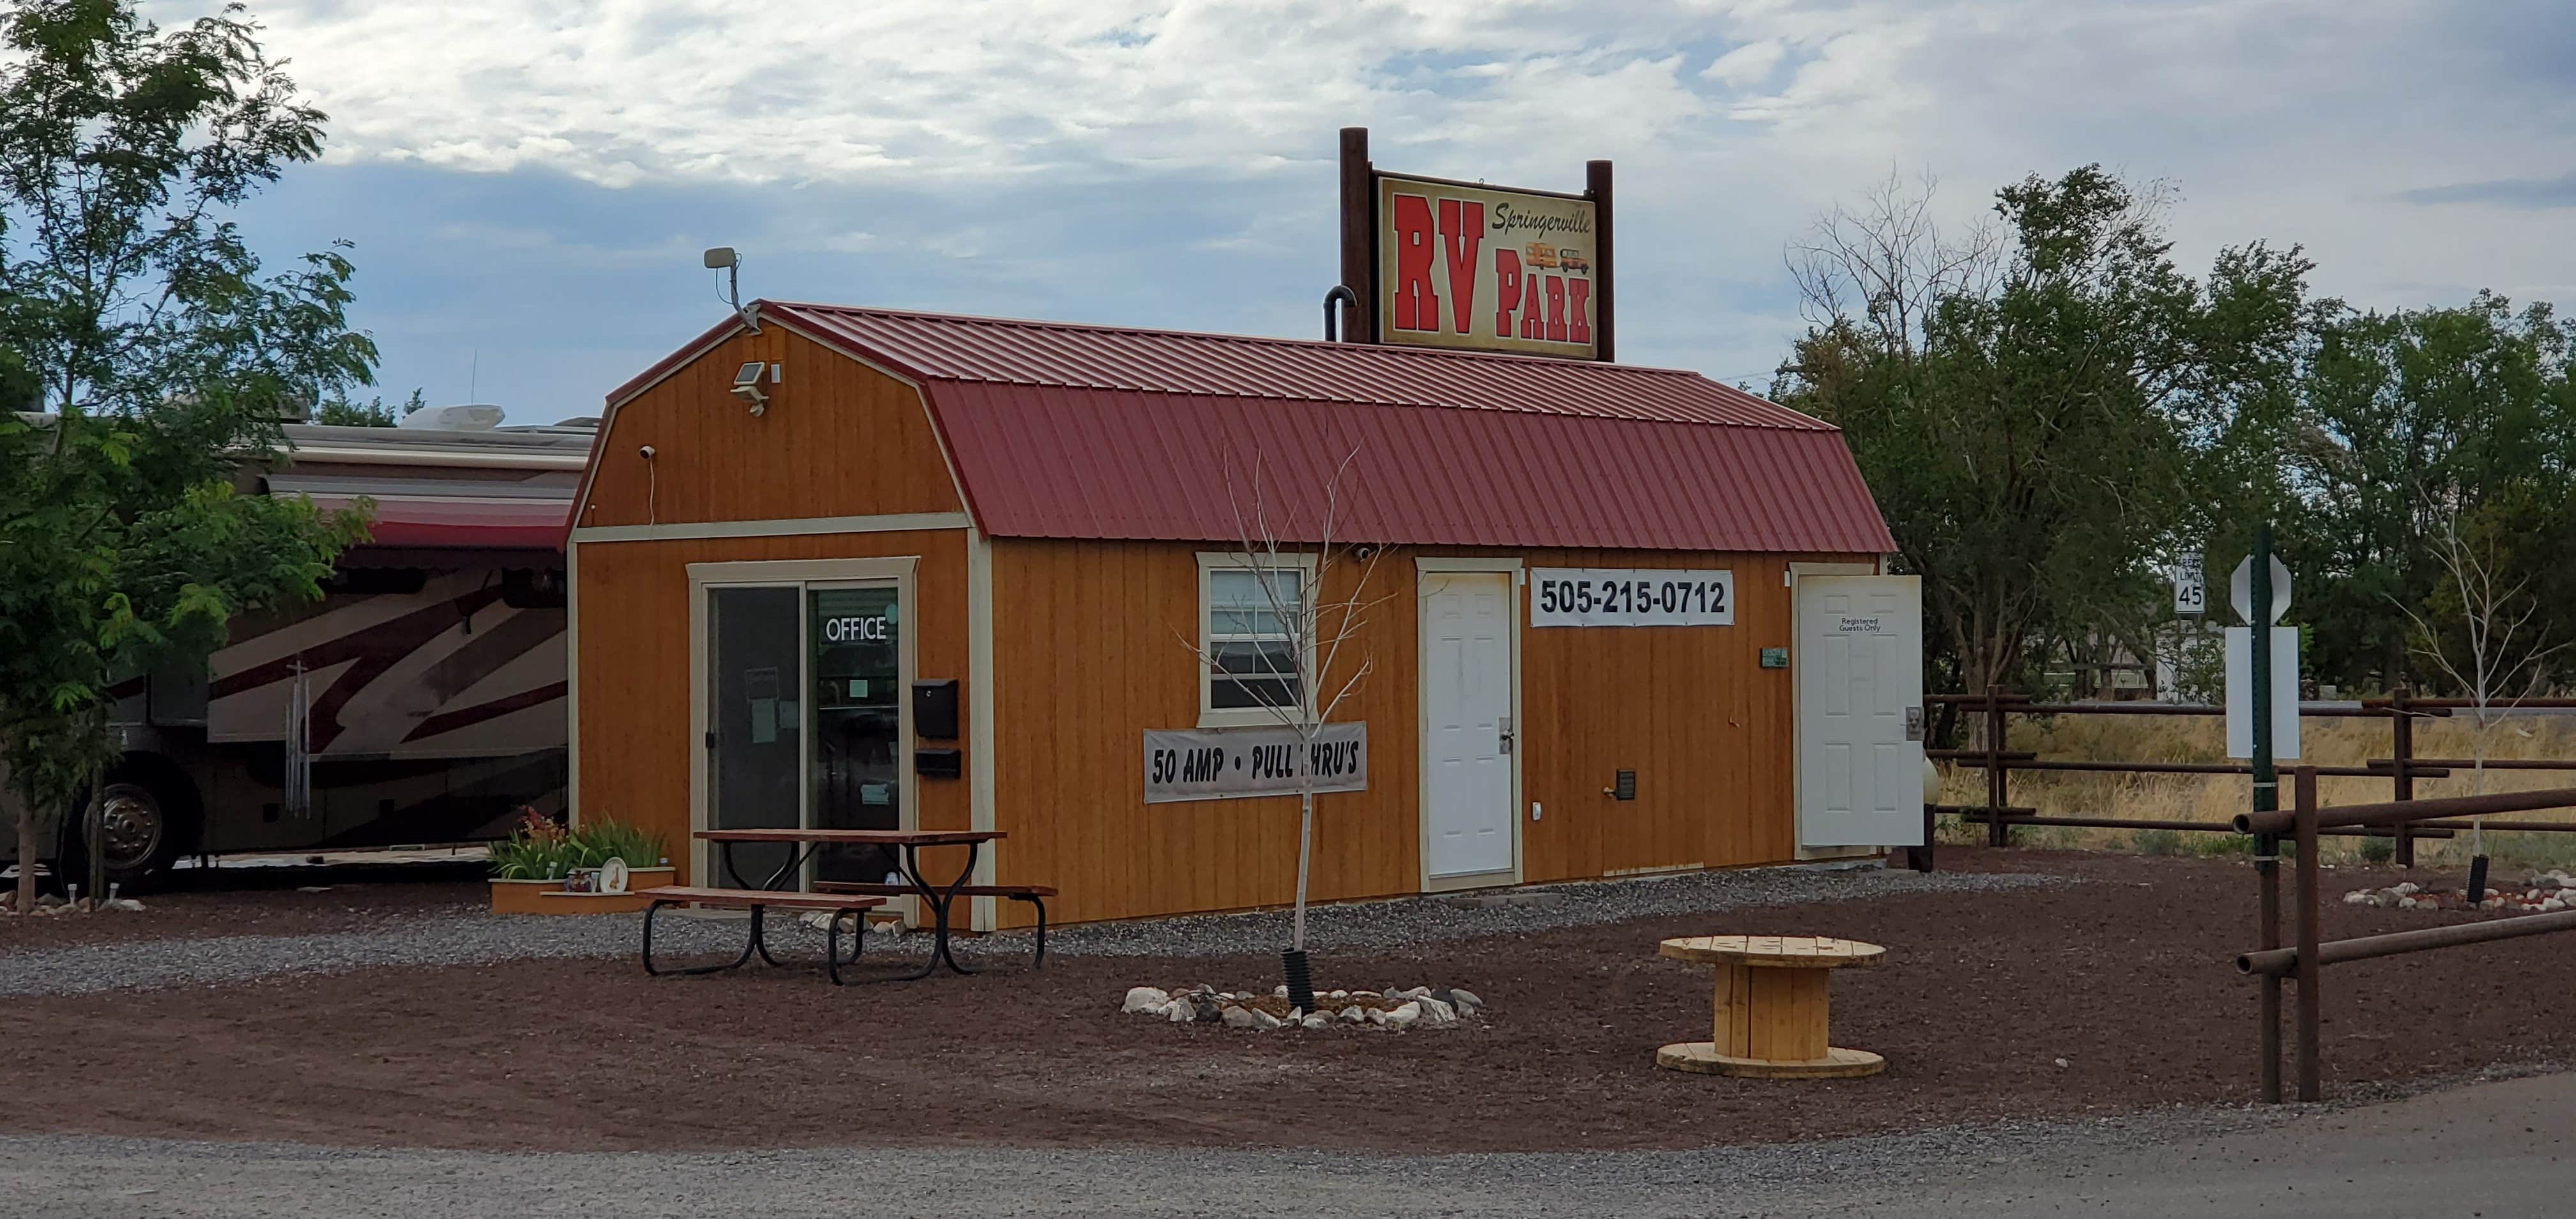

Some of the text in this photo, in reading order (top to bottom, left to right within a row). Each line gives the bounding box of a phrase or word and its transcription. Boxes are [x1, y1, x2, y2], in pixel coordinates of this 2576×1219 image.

[1491, 202, 1591, 239] Springerville
[1393, 192, 1484, 334] RV
[1495, 248, 1591, 346] PARK
[1540, 580, 1726, 613] 505-215-0712
[2179, 586, 2202, 605] 45
[826, 616, 887, 641] OFFICE
[1841, 617, 1878, 625] Registered
[1153, 749, 1176, 784] 50
[1183, 747, 1225, 783] AMP
[1252, 744, 1293, 779] PULL
